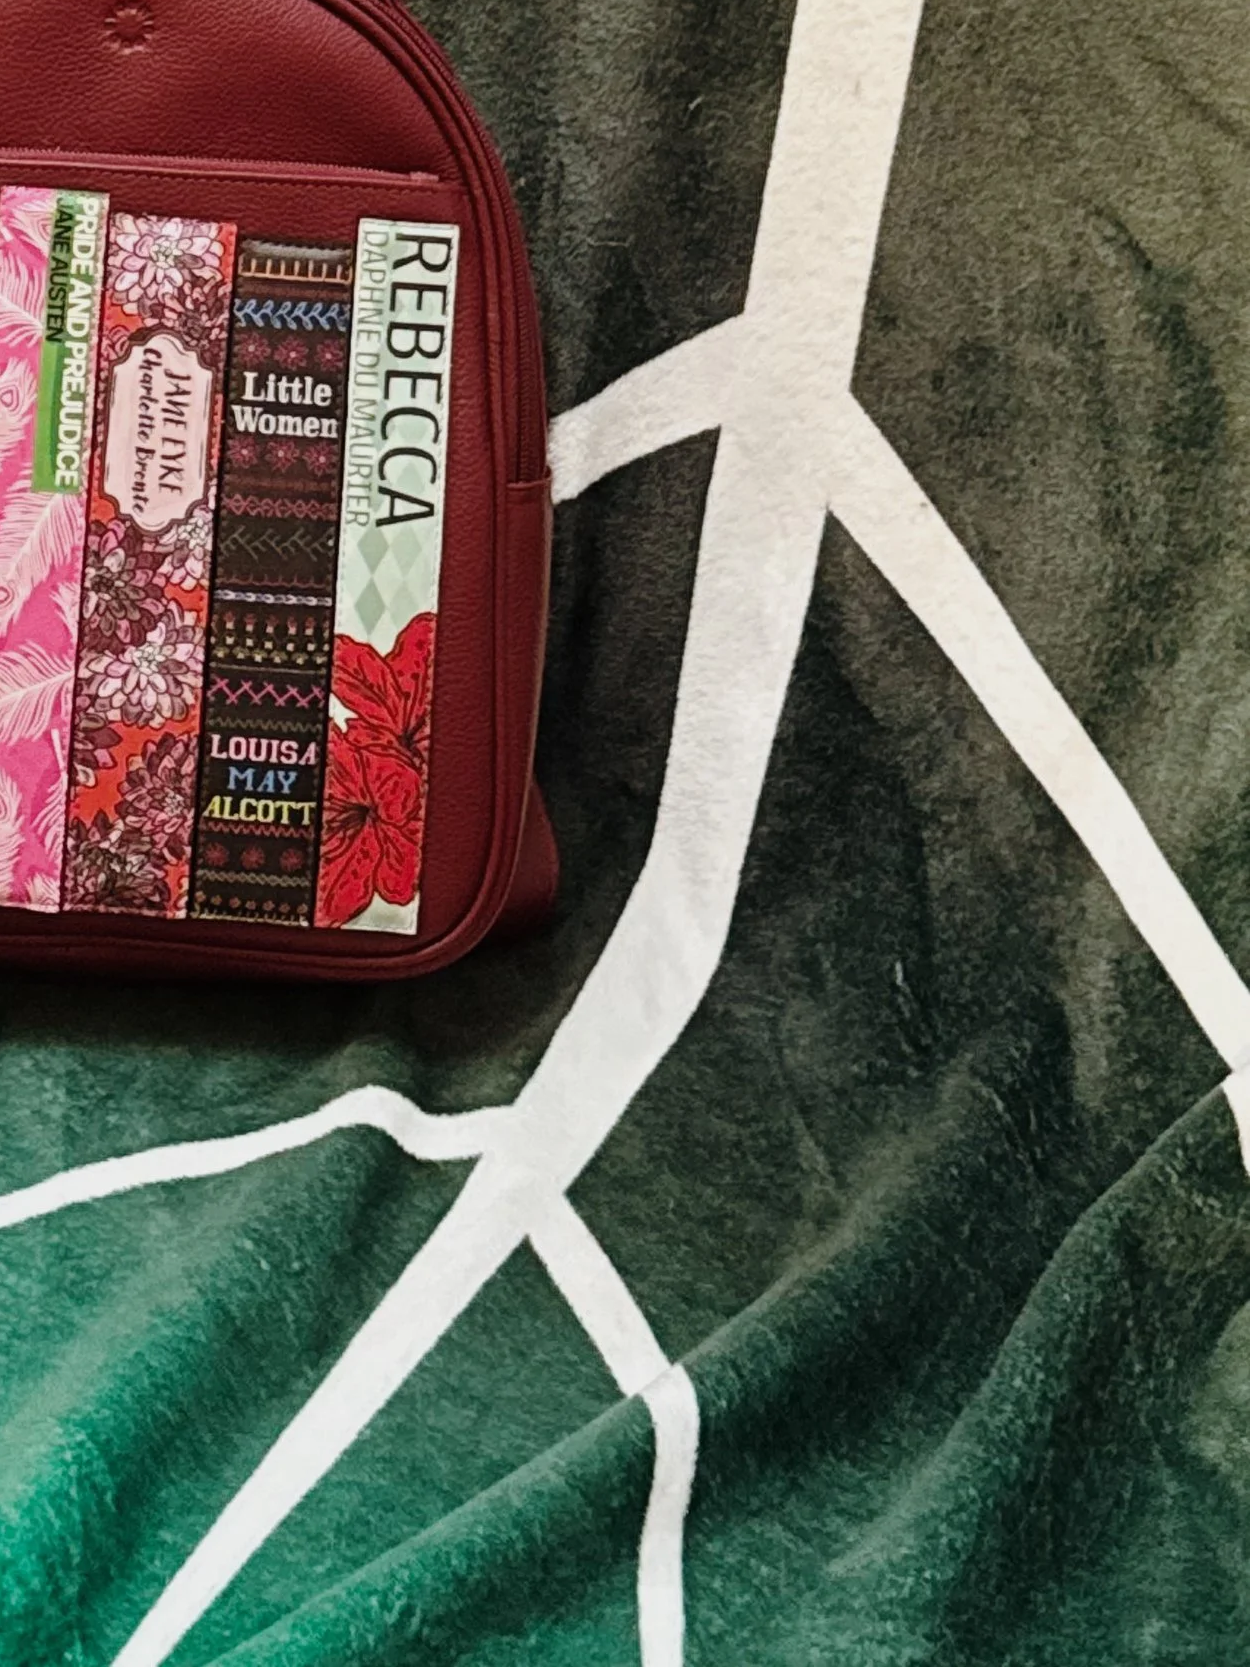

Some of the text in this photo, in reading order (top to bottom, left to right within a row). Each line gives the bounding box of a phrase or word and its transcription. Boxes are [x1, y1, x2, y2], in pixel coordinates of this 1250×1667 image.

[45, 196, 74, 344] JANE AUSTEN
[55, 196, 99, 488] PRIDE AND PREJUDICE
[137, 347, 163, 443] Charlotte
[161, 368, 192, 431] JANE
[241, 371, 333, 406] Little
[344, 230, 389, 528] DAPHNE DU MAURIER
[375, 232, 451, 528] REBECCA
[231, 404, 338, 439] Women
[210, 733, 317, 765] LOUISA
[227, 766, 298, 794] MAY
[202, 795, 317, 826] ALCOTT
